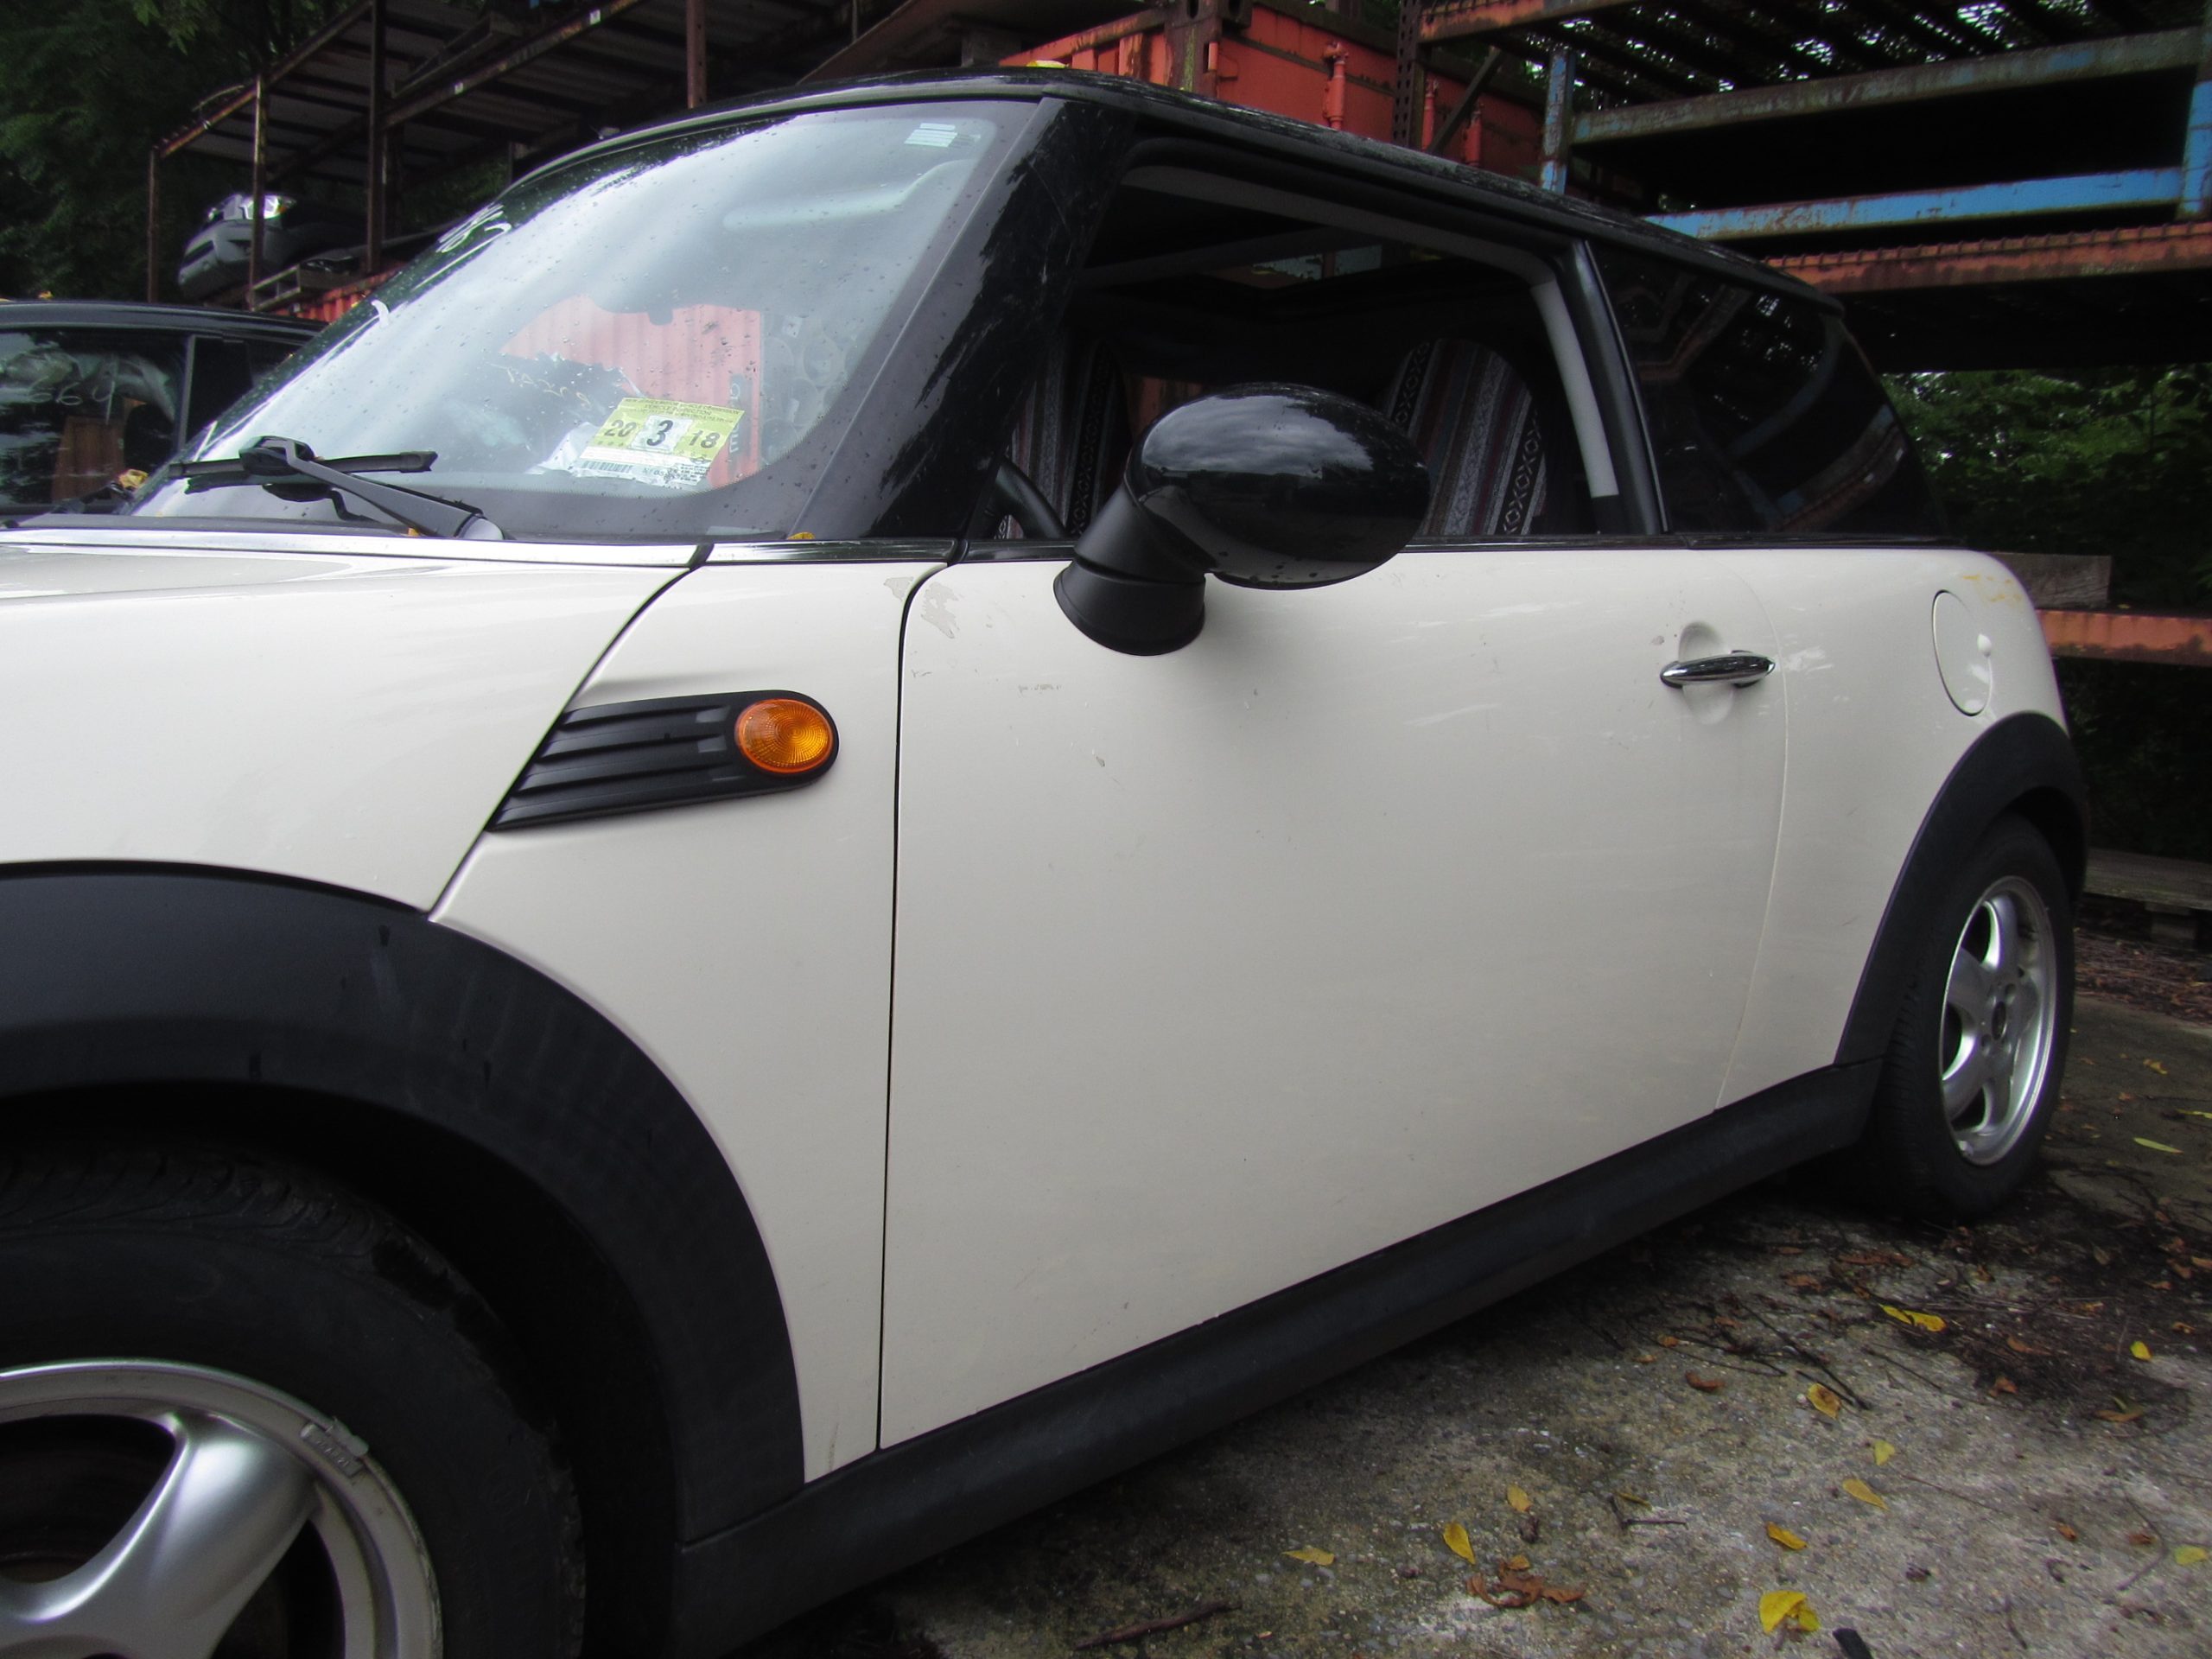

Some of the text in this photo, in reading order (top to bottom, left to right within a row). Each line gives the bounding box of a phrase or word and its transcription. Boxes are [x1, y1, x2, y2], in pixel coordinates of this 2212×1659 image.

[604, 419, 721, 449] 20 3 18
